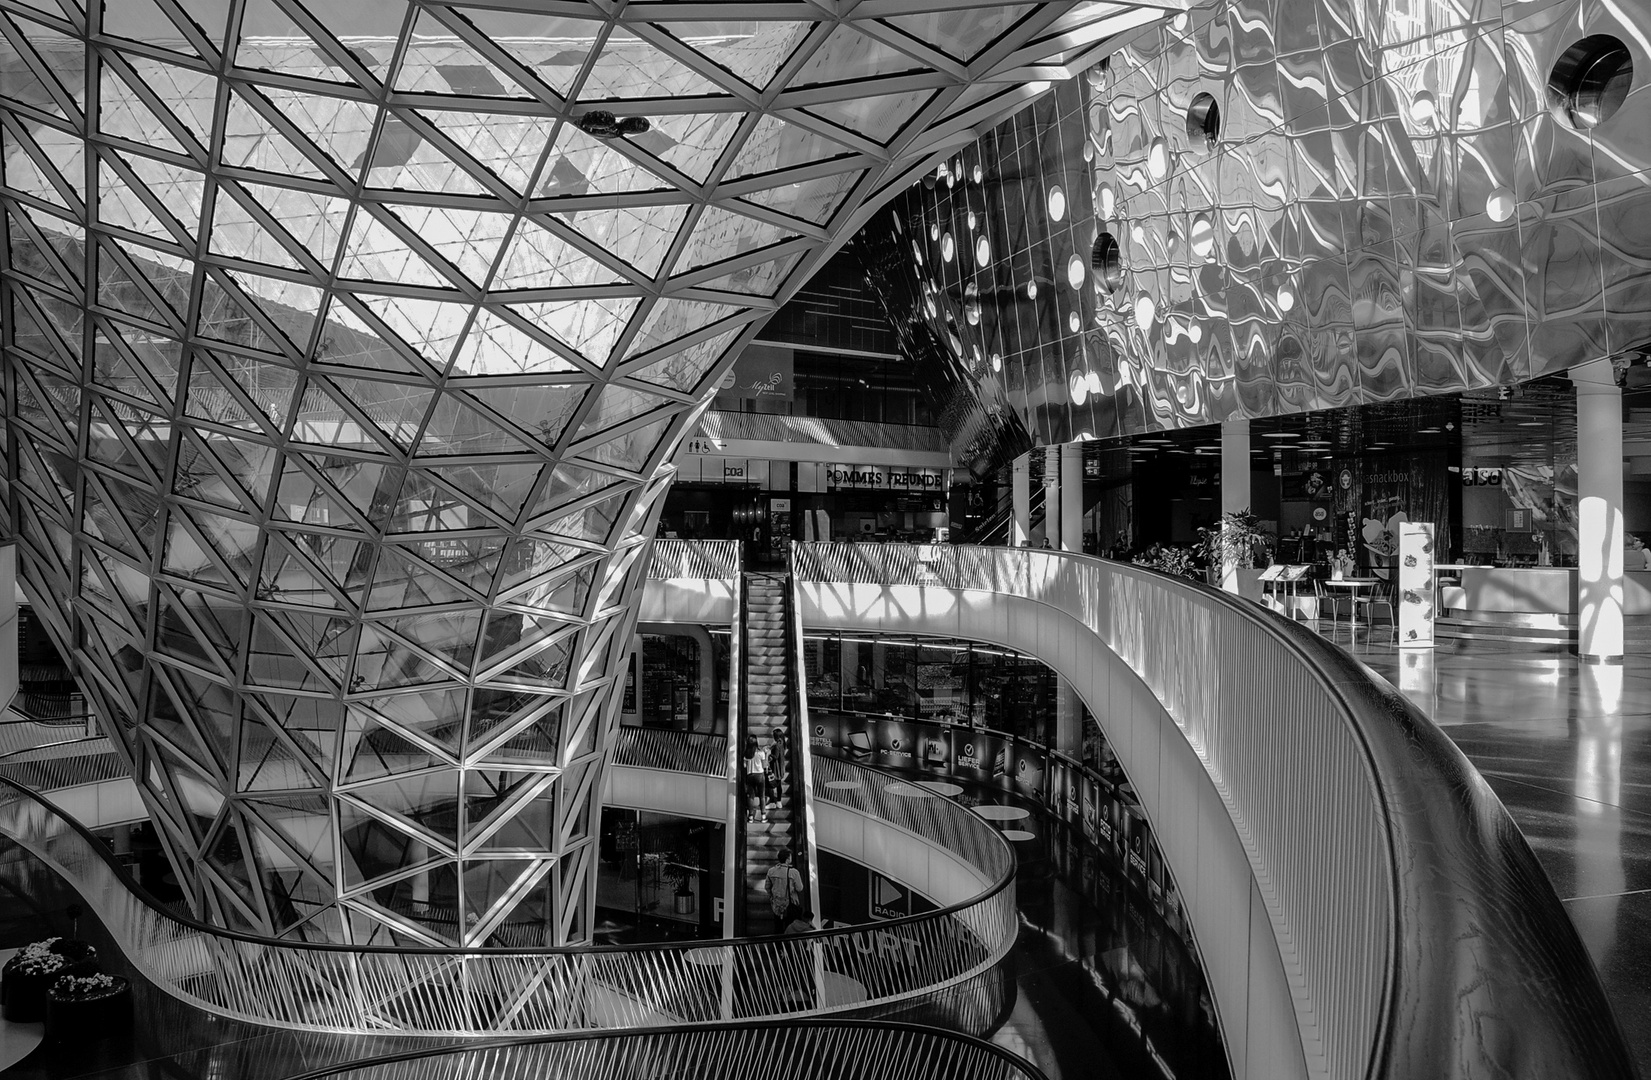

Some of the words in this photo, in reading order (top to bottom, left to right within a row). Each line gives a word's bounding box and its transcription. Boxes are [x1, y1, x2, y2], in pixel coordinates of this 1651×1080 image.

[724, 466, 744, 477] coa
[826, 469, 882, 484] POMMES
[886, 471, 943, 487] FREUNDE
[874, 906, 905, 918] RADIO
